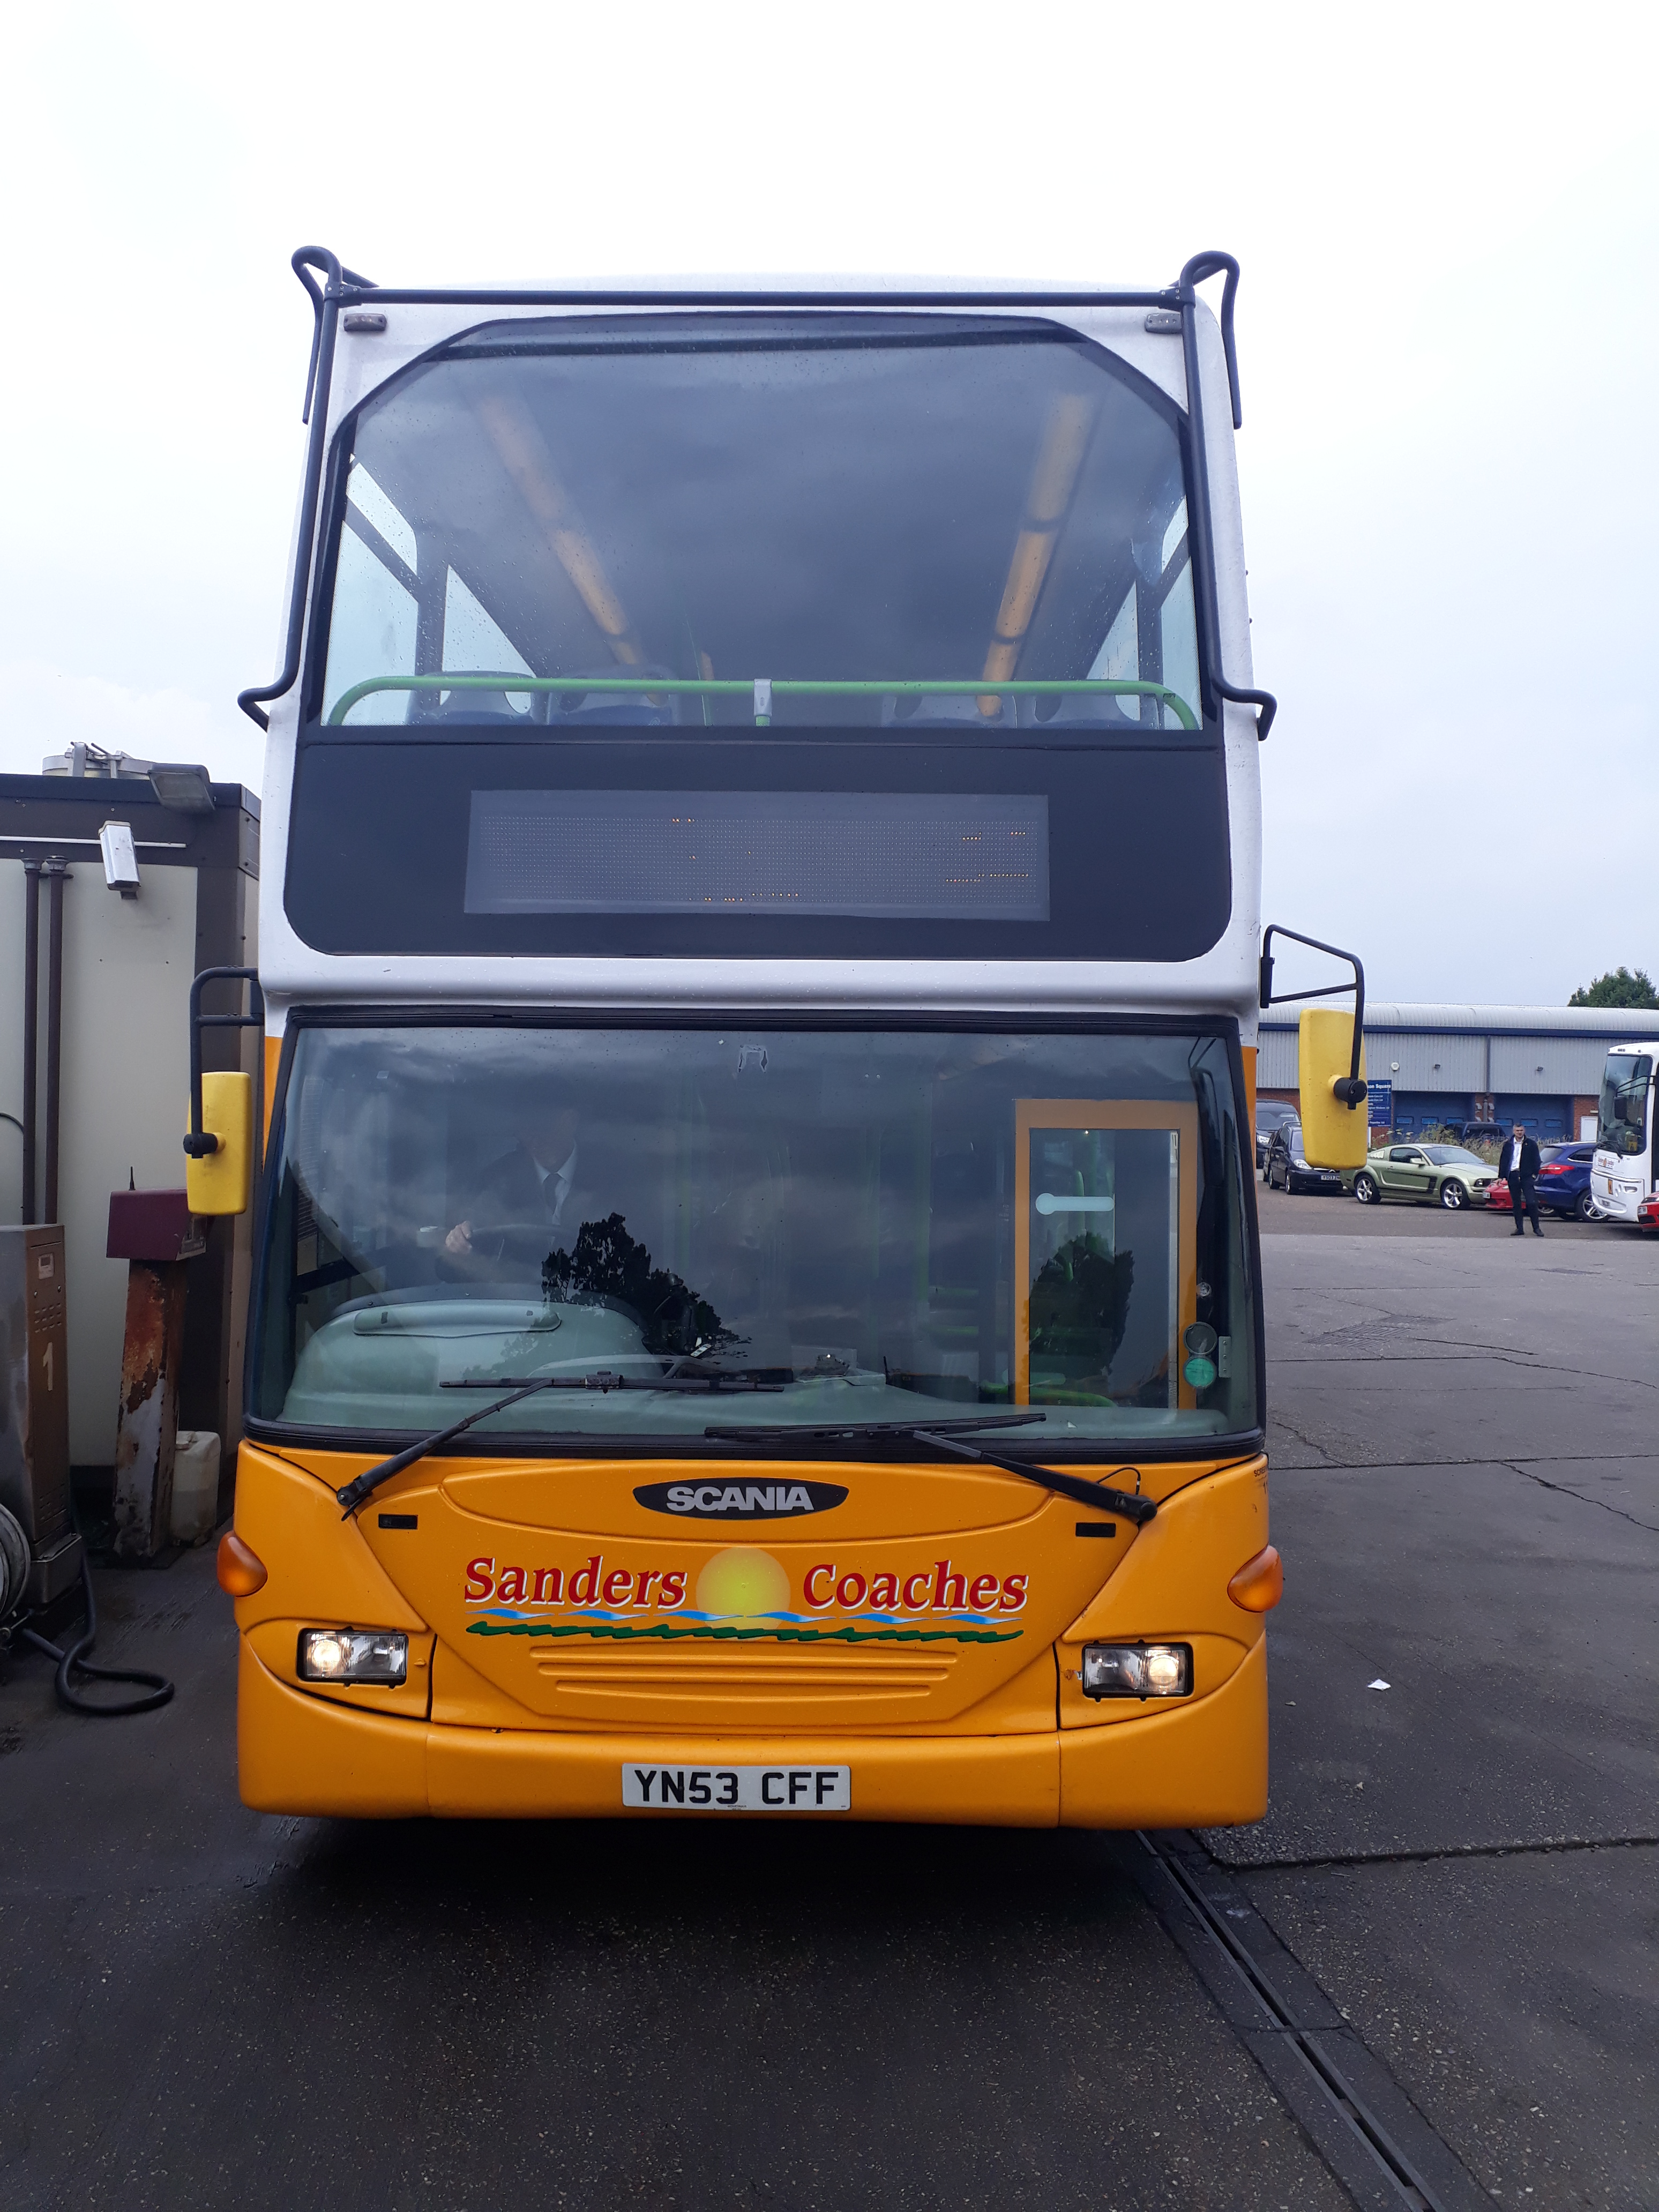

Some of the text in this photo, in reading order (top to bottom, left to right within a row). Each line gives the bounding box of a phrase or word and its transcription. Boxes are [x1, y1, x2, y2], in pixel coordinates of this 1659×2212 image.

[43, 1342, 53, 1391] 1
[667, 1486, 814, 1511] SCANIA
[465, 1555, 1029, 1612] Sanders Coaches
[634, 1770, 839, 1804] YN53 CFF
